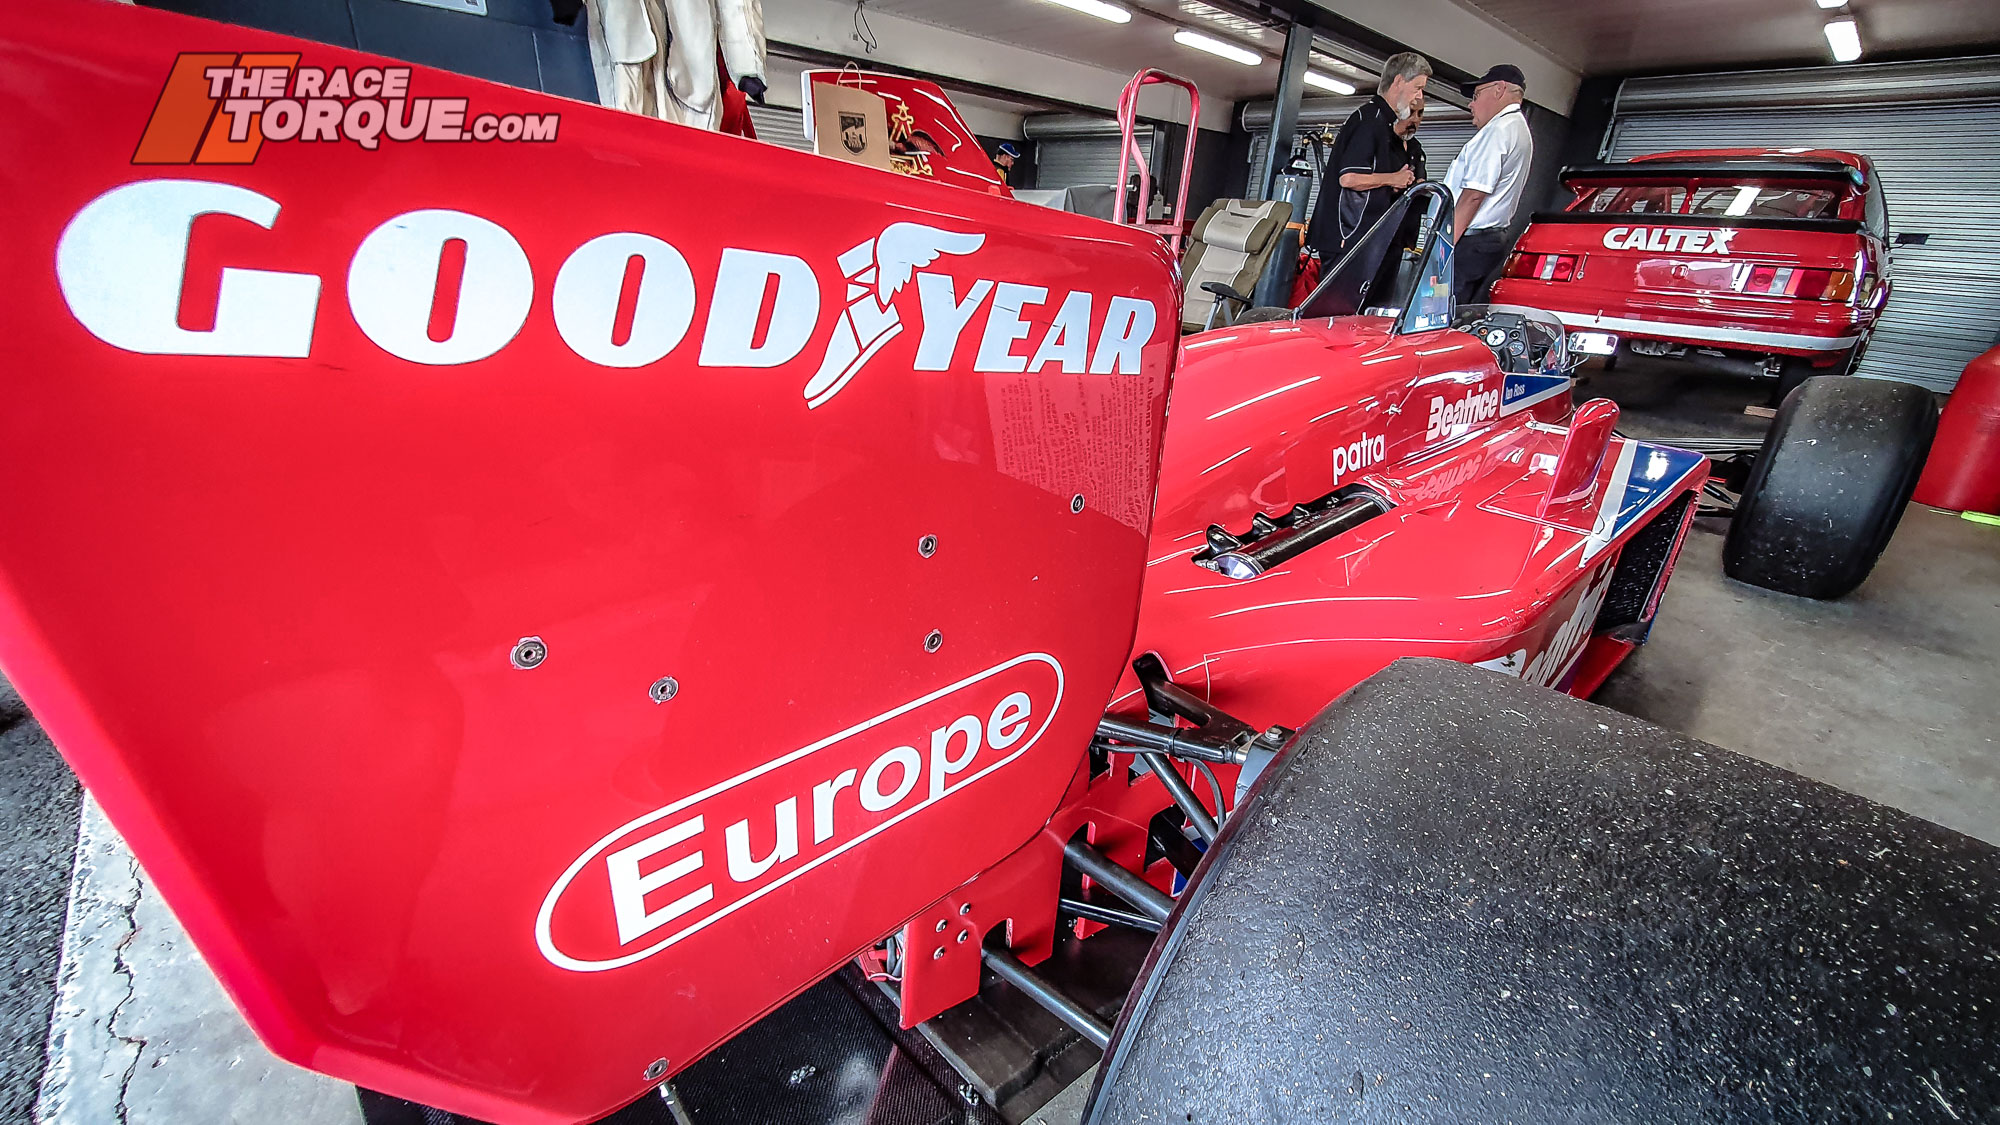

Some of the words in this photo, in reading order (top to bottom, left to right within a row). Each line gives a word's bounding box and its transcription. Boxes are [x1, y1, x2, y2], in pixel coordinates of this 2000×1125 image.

[1602, 227, 1738, 255] CALTEX
[1425, 383, 1499, 443] Beatrice
[1332, 432, 1386, 486] patra
[606, 691, 1032, 946] Europe
